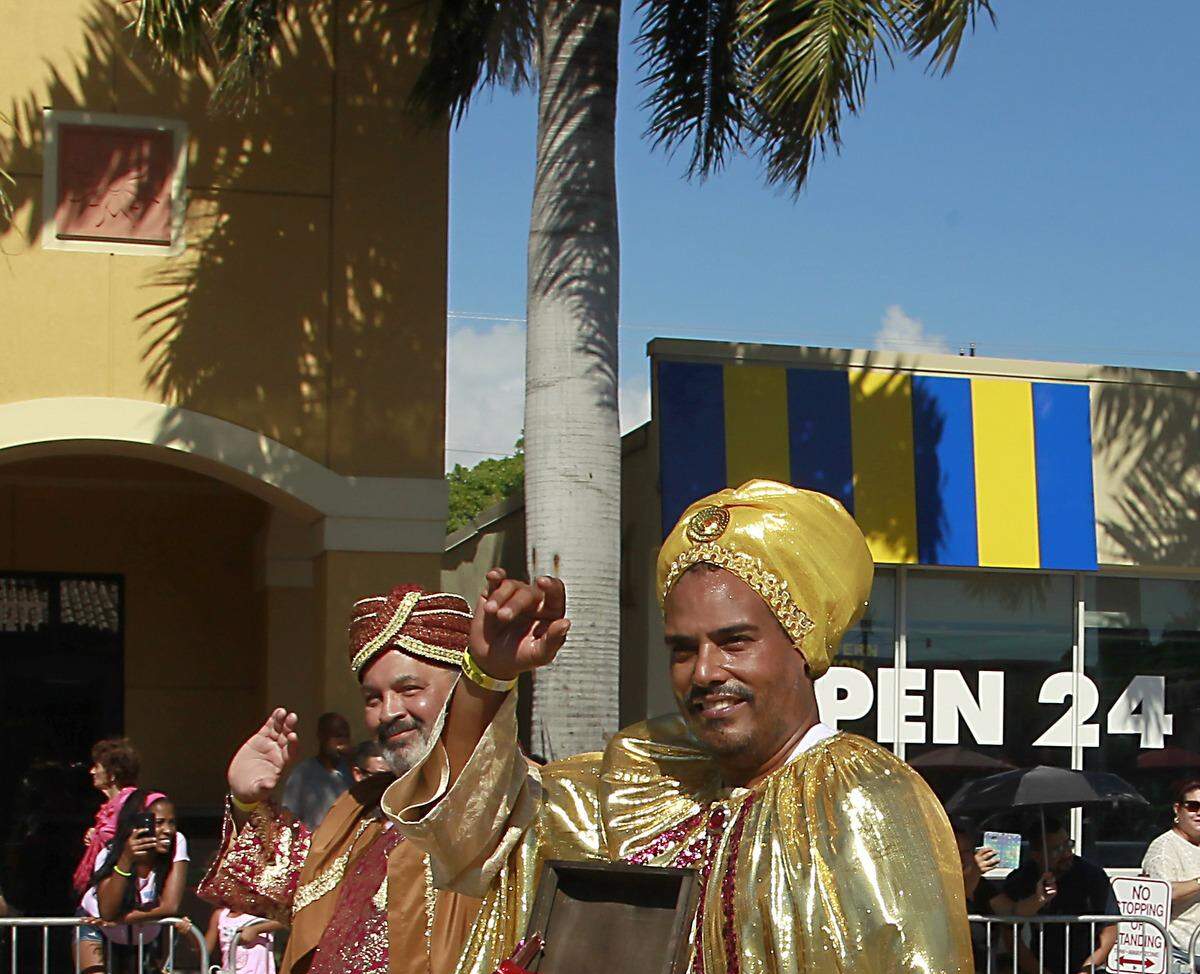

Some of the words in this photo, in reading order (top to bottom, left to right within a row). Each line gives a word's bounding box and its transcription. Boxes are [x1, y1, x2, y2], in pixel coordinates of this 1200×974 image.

[814, 666, 1005, 745] PEN
[1032, 671, 1173, 749] 24
[1132, 886, 1151, 901] NO
[1118, 901, 1164, 917] TOPPING
[1117, 933, 1162, 949] TANDING
